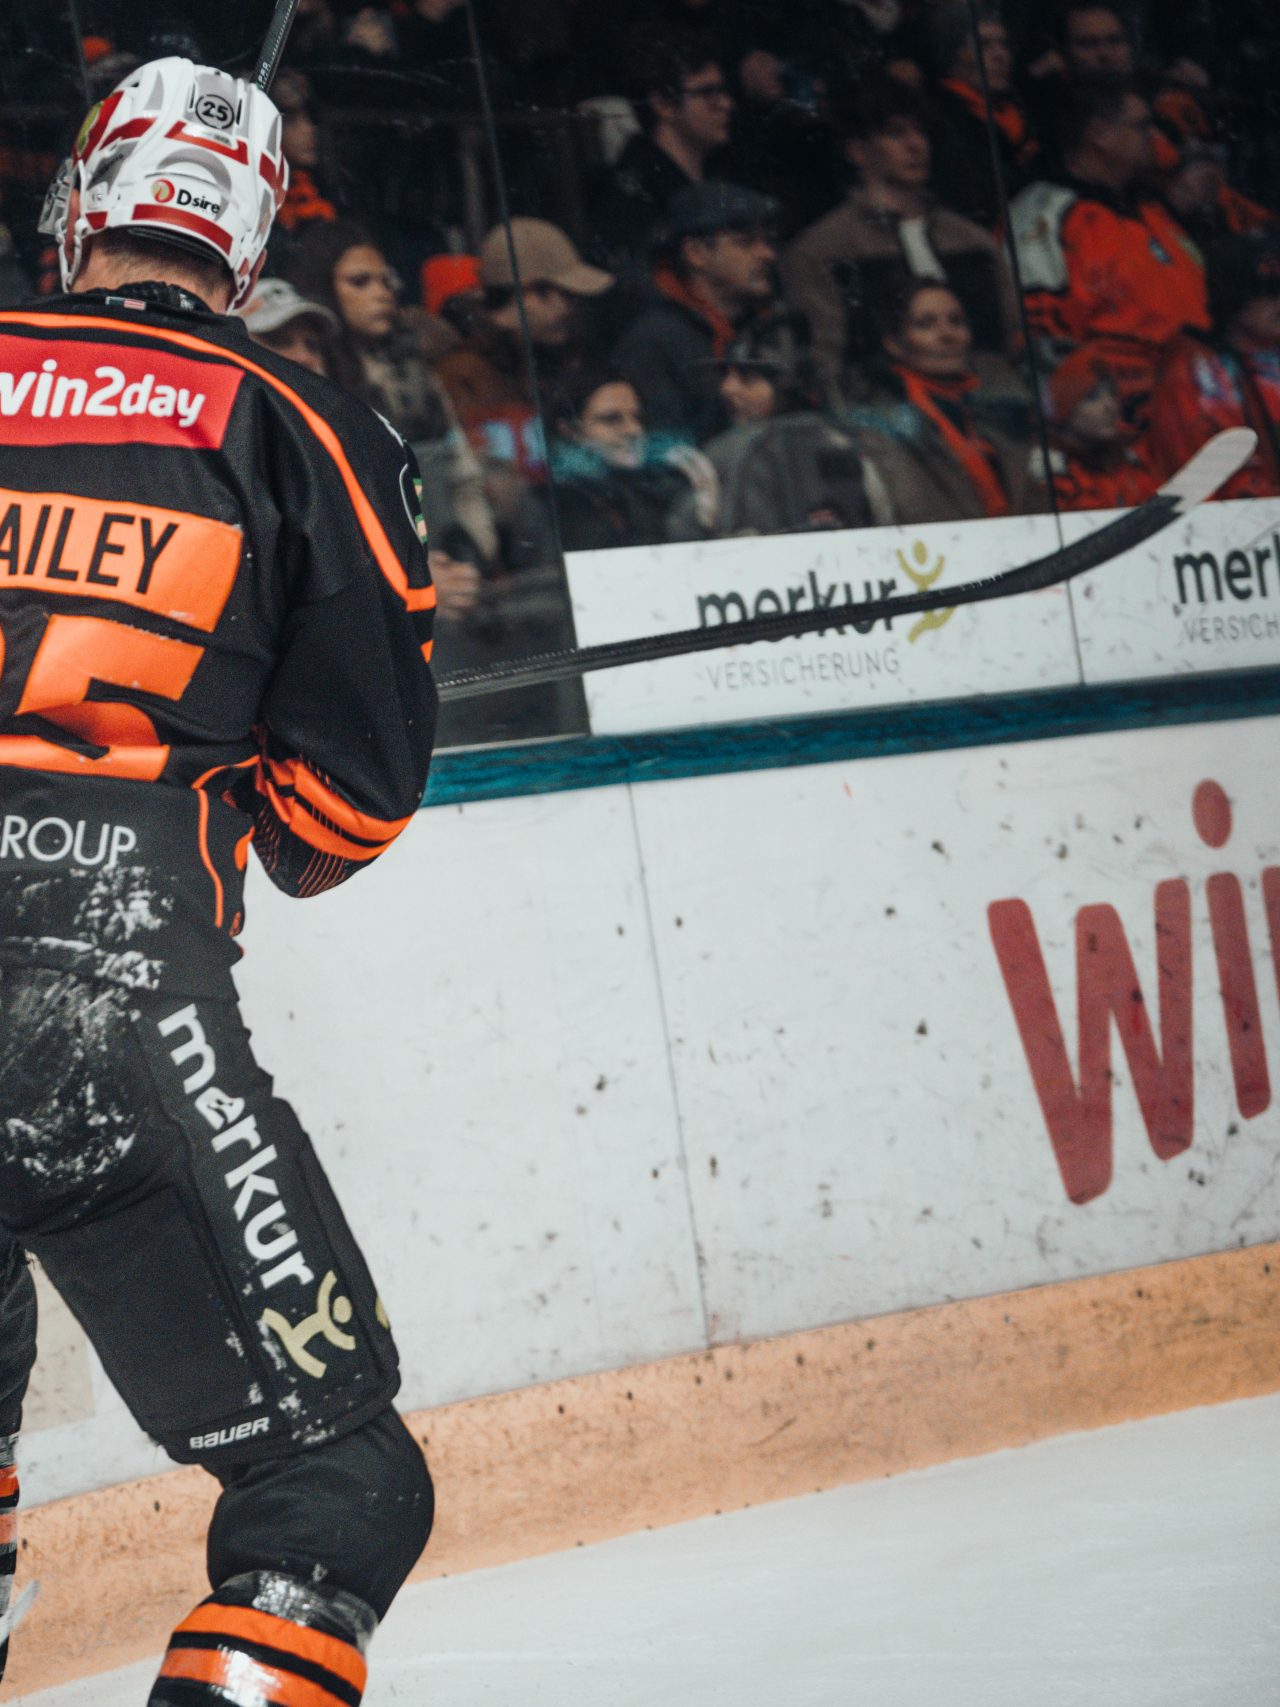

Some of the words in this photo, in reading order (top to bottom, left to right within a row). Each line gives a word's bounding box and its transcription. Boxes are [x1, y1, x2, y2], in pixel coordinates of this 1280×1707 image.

[201, 100, 230, 123] 25
[176, 188, 221, 214] Dsire
[1174, 531, 1280, 604] mer
[706, 647, 900, 691] VERSICHERUNG
[157, 1003, 315, 1289] merkur
[189, 1416, 271, 1450] BAUER
